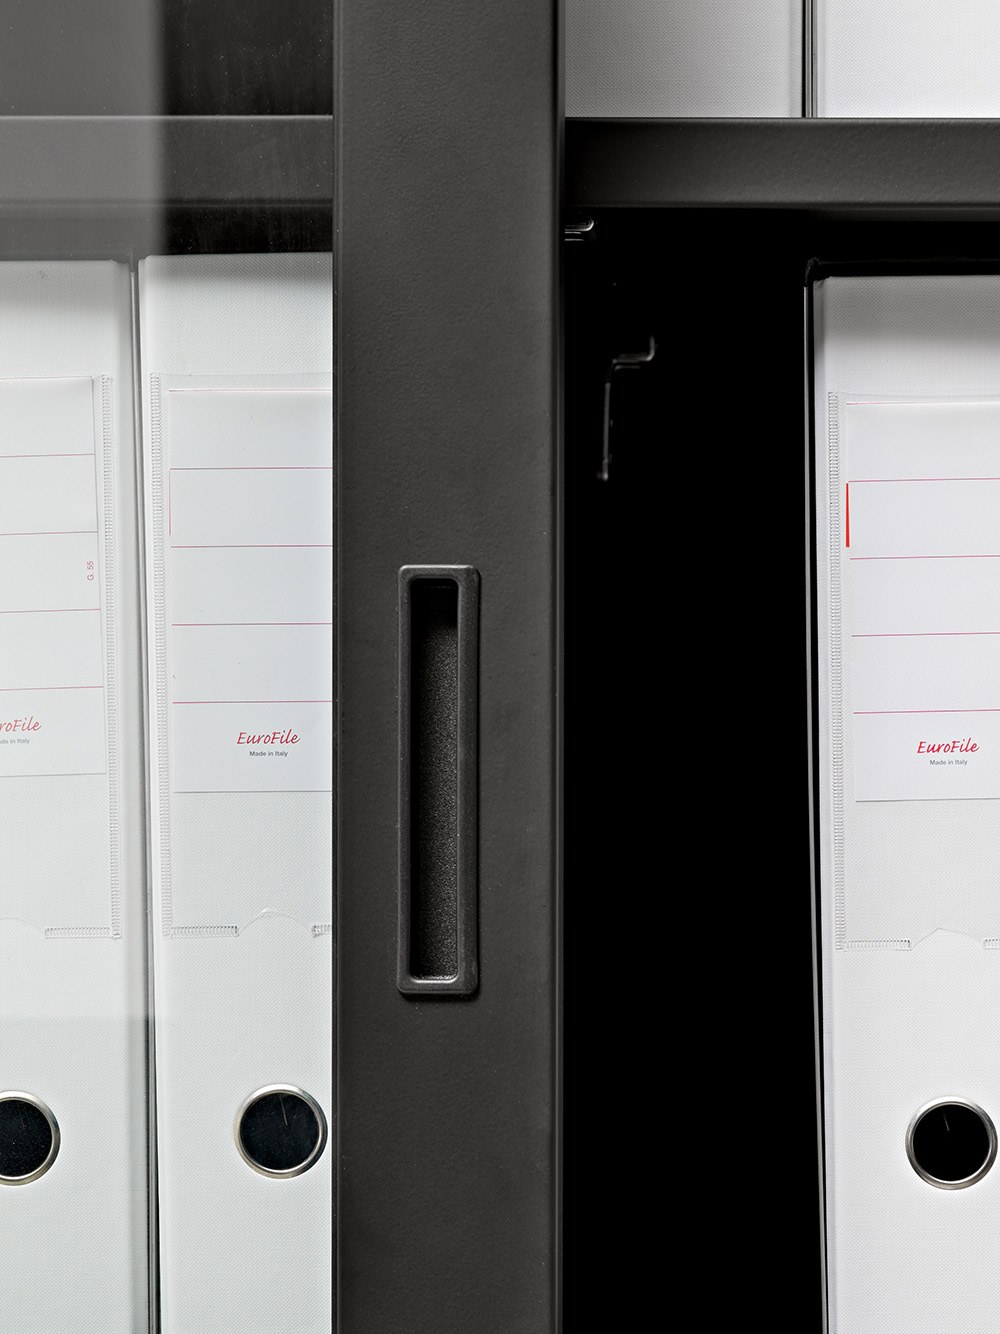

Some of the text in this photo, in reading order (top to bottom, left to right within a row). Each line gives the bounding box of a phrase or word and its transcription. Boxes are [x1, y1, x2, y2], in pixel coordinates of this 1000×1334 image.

[87, 560, 94, 570] 55
[0, 715, 42, 732] roFile
[236, 728, 301, 745] EuroFile
[917, 737, 981, 754] EuroFile
